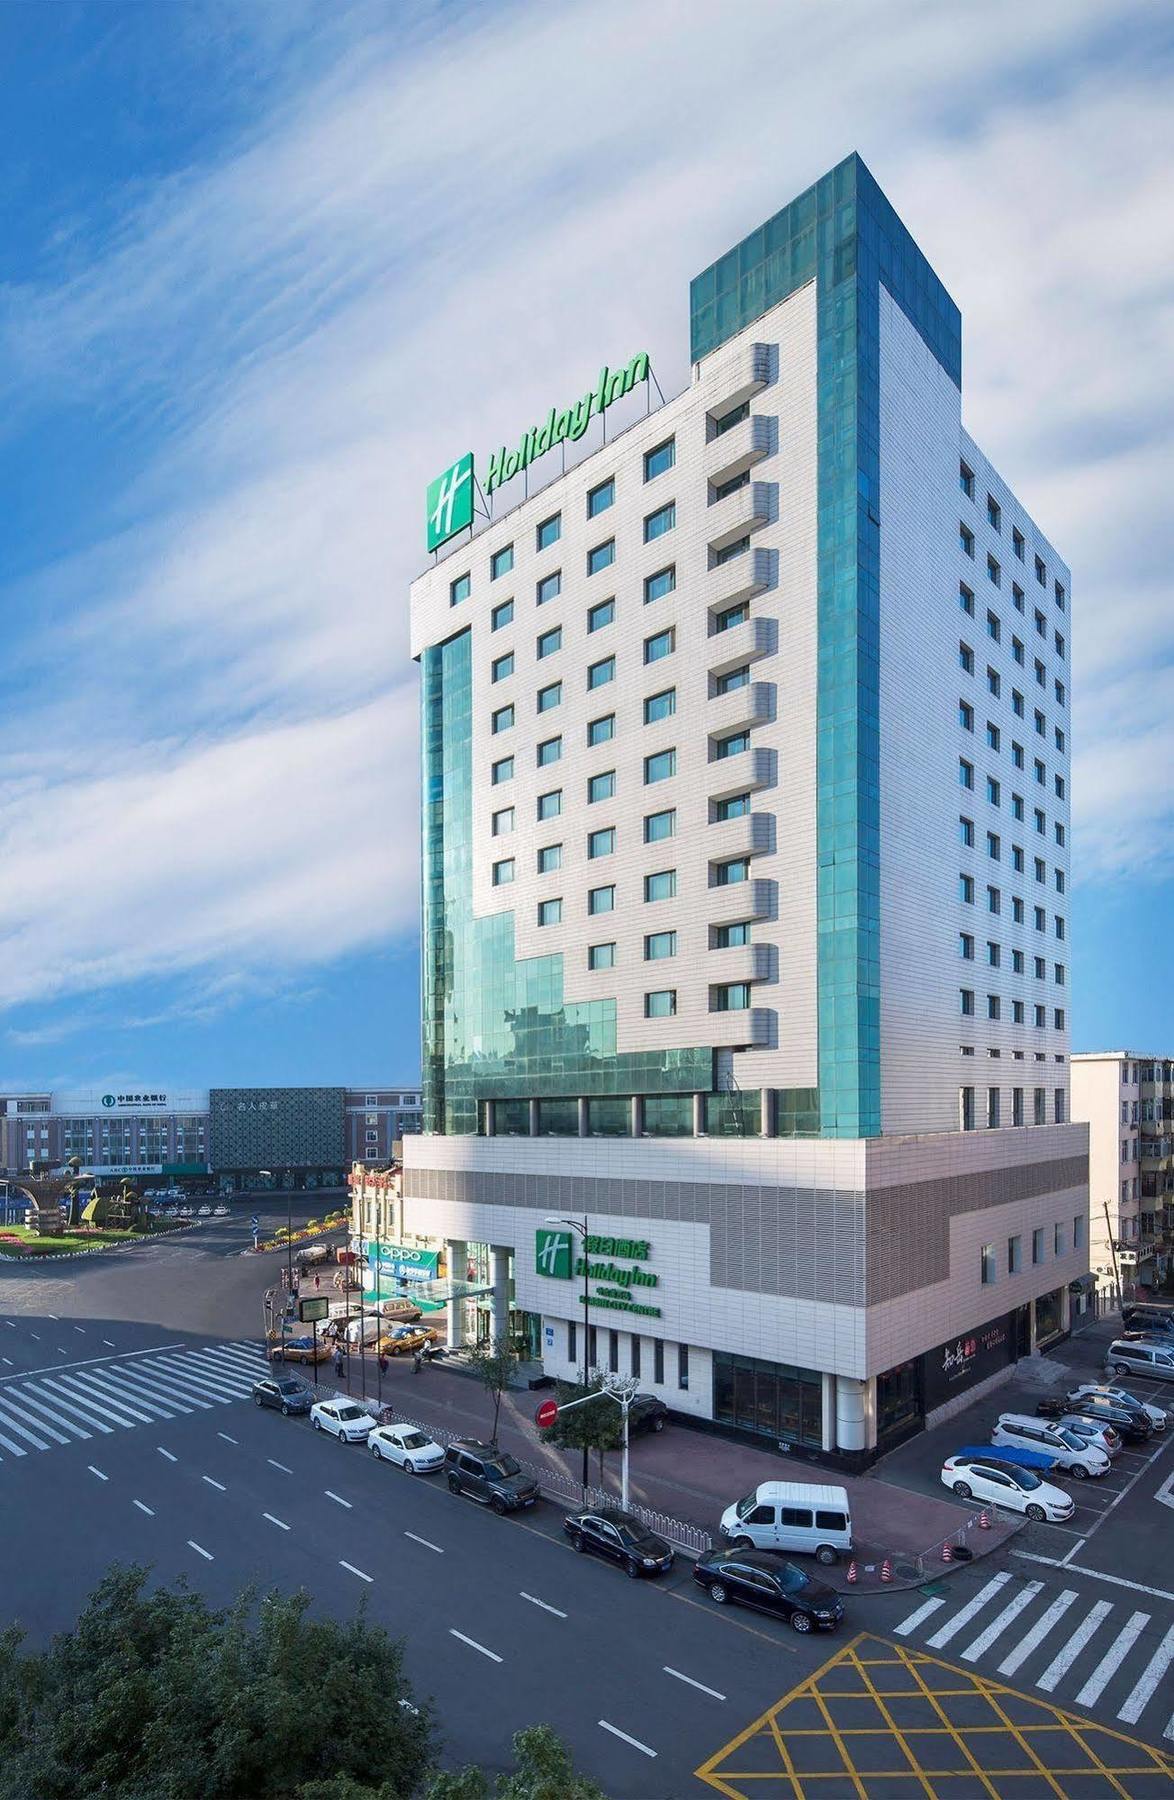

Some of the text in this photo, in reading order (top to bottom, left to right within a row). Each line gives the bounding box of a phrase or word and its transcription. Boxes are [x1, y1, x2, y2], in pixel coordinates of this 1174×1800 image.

[483, 351, 649, 495] Holiday Inn
[581, 1235, 651, 1260] 假日酒店
[575, 1258, 658, 1288] Holiday Inn
